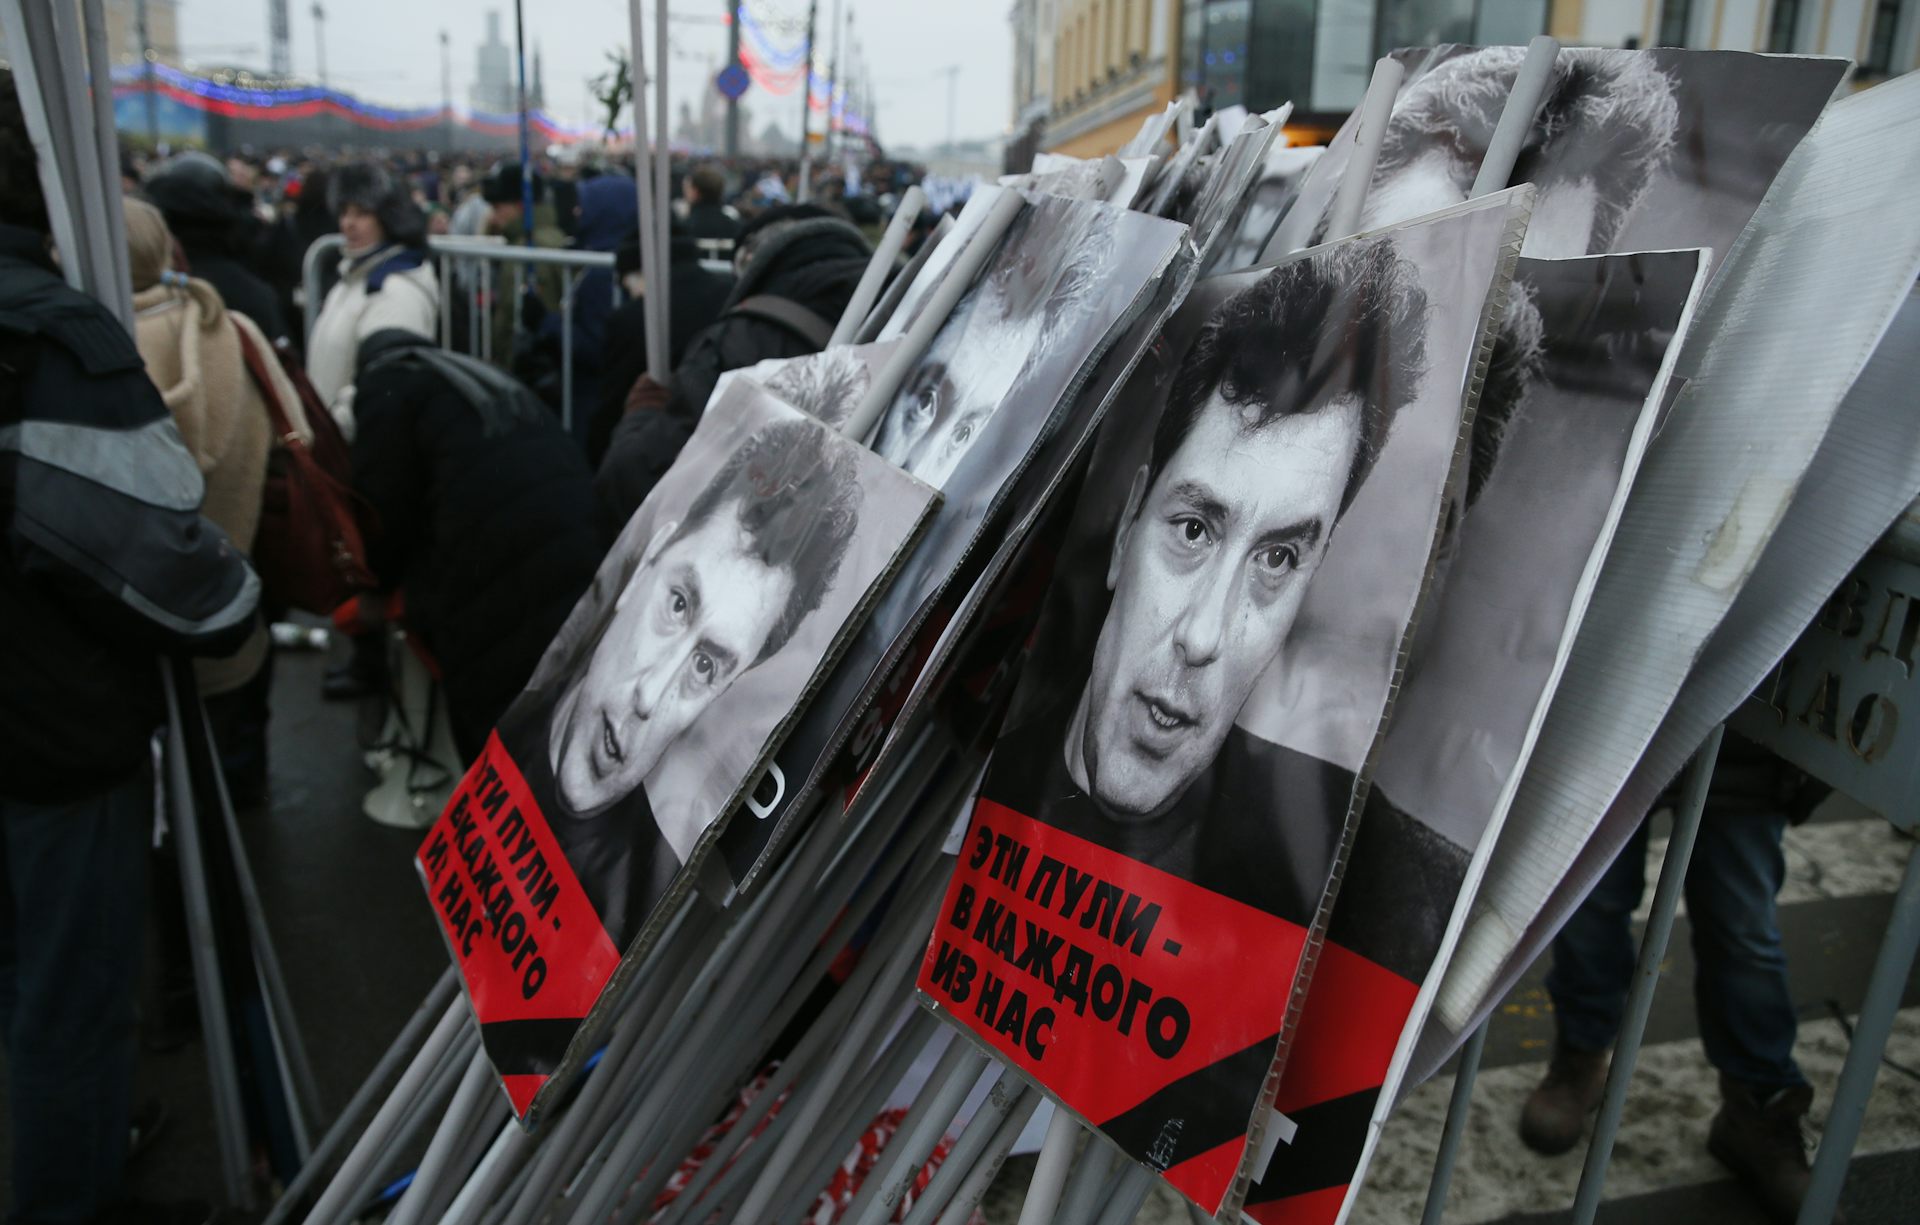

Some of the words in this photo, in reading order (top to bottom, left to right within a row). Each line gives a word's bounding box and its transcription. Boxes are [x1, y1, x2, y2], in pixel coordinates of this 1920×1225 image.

[438, 870, 484, 957] НАС
[496, 805, 561, 921] ПУЛИ
[969, 825, 1031, 890] ЭТИ
[1024, 855, 1162, 958] ПУЛИ
[930, 939, 978, 1004] ИЗ
[975, 970, 1057, 1062] НАС
[949, 883, 976, 931] В
[972, 898, 1192, 1060] КАЖДОГО
